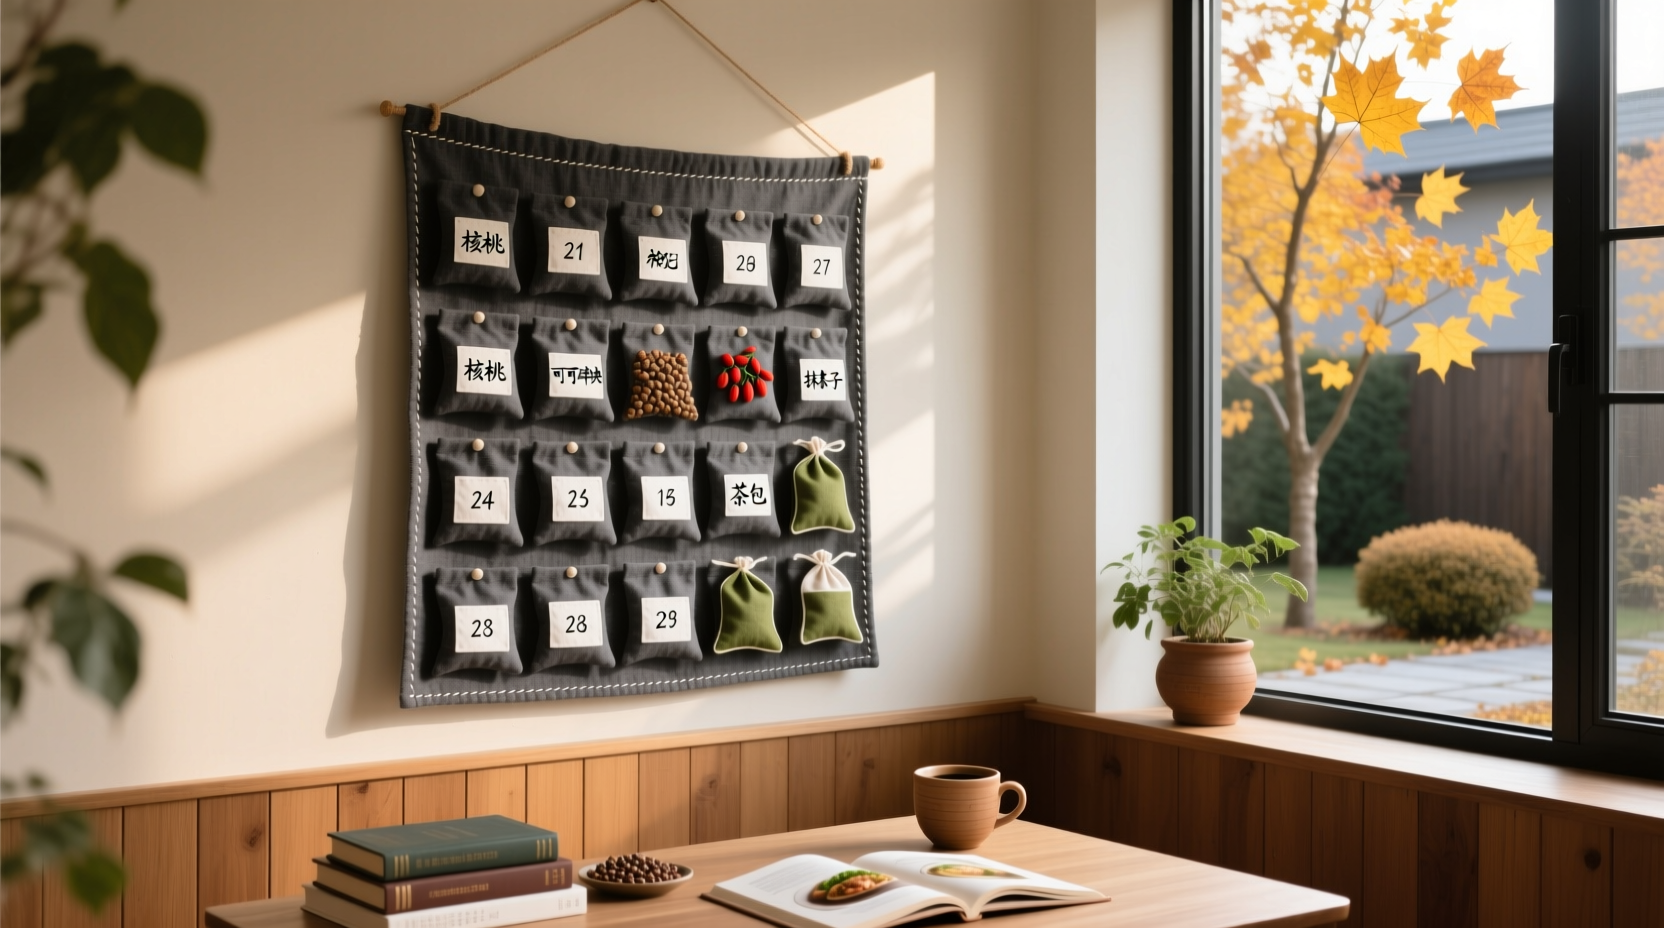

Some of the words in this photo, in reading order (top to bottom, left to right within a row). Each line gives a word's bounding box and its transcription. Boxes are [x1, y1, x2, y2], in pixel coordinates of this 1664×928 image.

[461, 230, 506, 254] 核桃
[563, 241, 584, 261] 21
[813, 258, 831, 276] 27
[464, 358, 506, 382] 核桃
[470, 490, 495, 511] 24
[731, 481, 768, 507] 茶包
[470, 618, 494, 638] 28
[565, 614, 588, 634] 28
